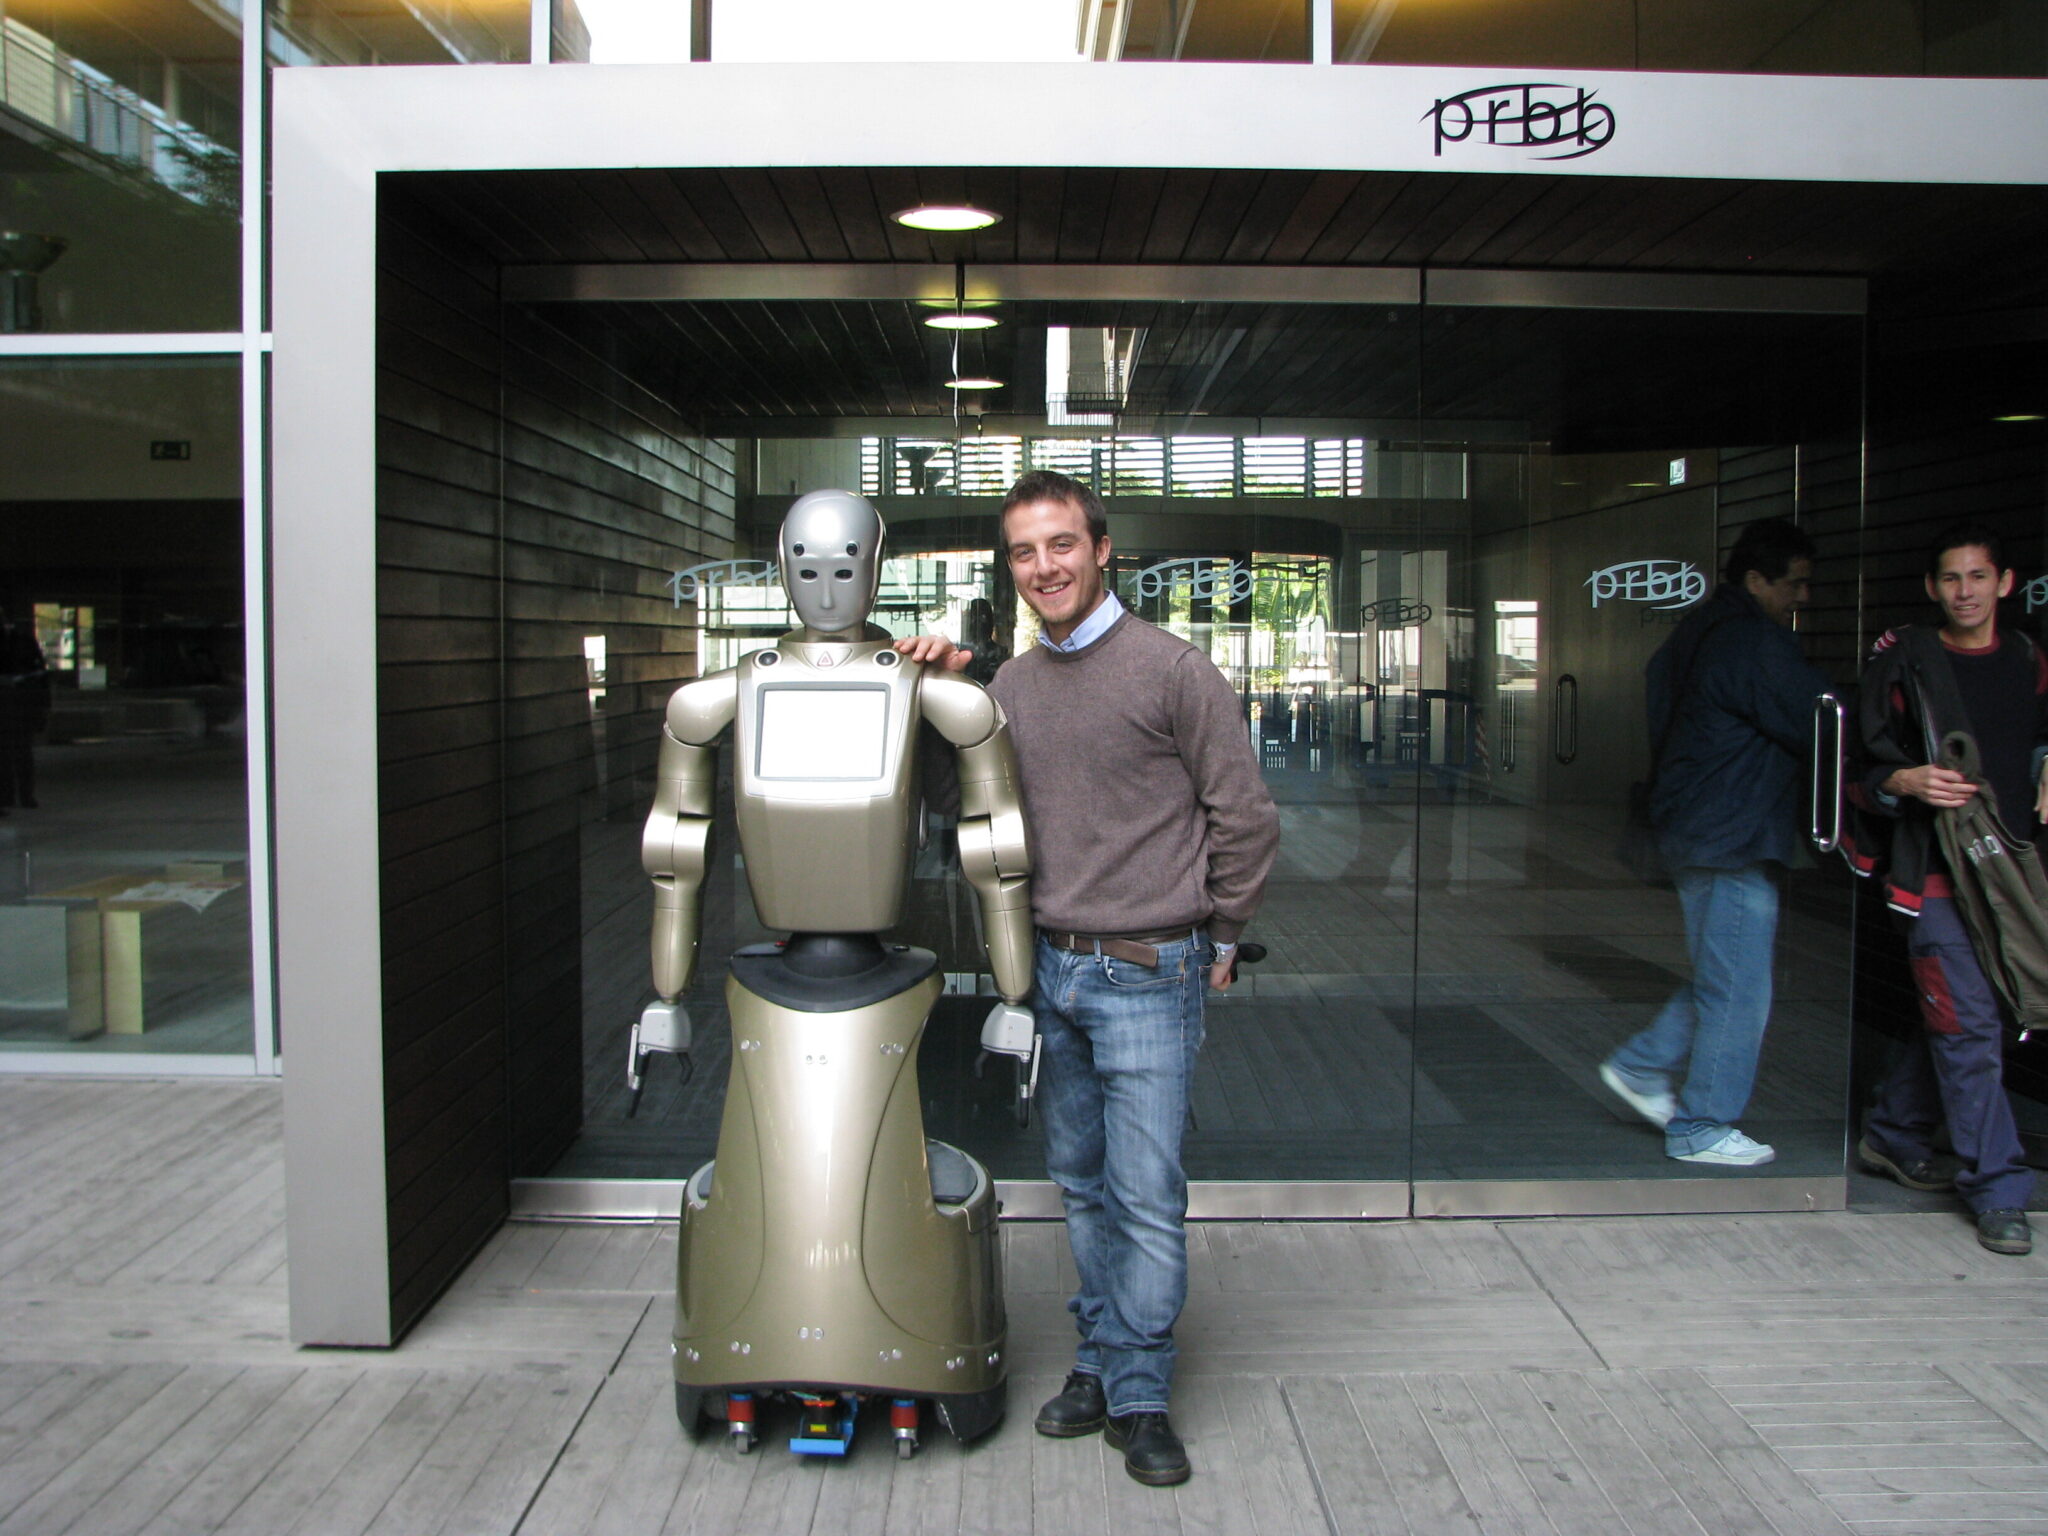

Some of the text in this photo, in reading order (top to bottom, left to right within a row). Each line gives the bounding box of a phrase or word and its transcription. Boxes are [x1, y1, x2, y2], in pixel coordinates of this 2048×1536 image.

[1419, 83, 1616, 160] prbb
[1128, 557, 1254, 608] prbb
[1583, 560, 1706, 609] prbb
